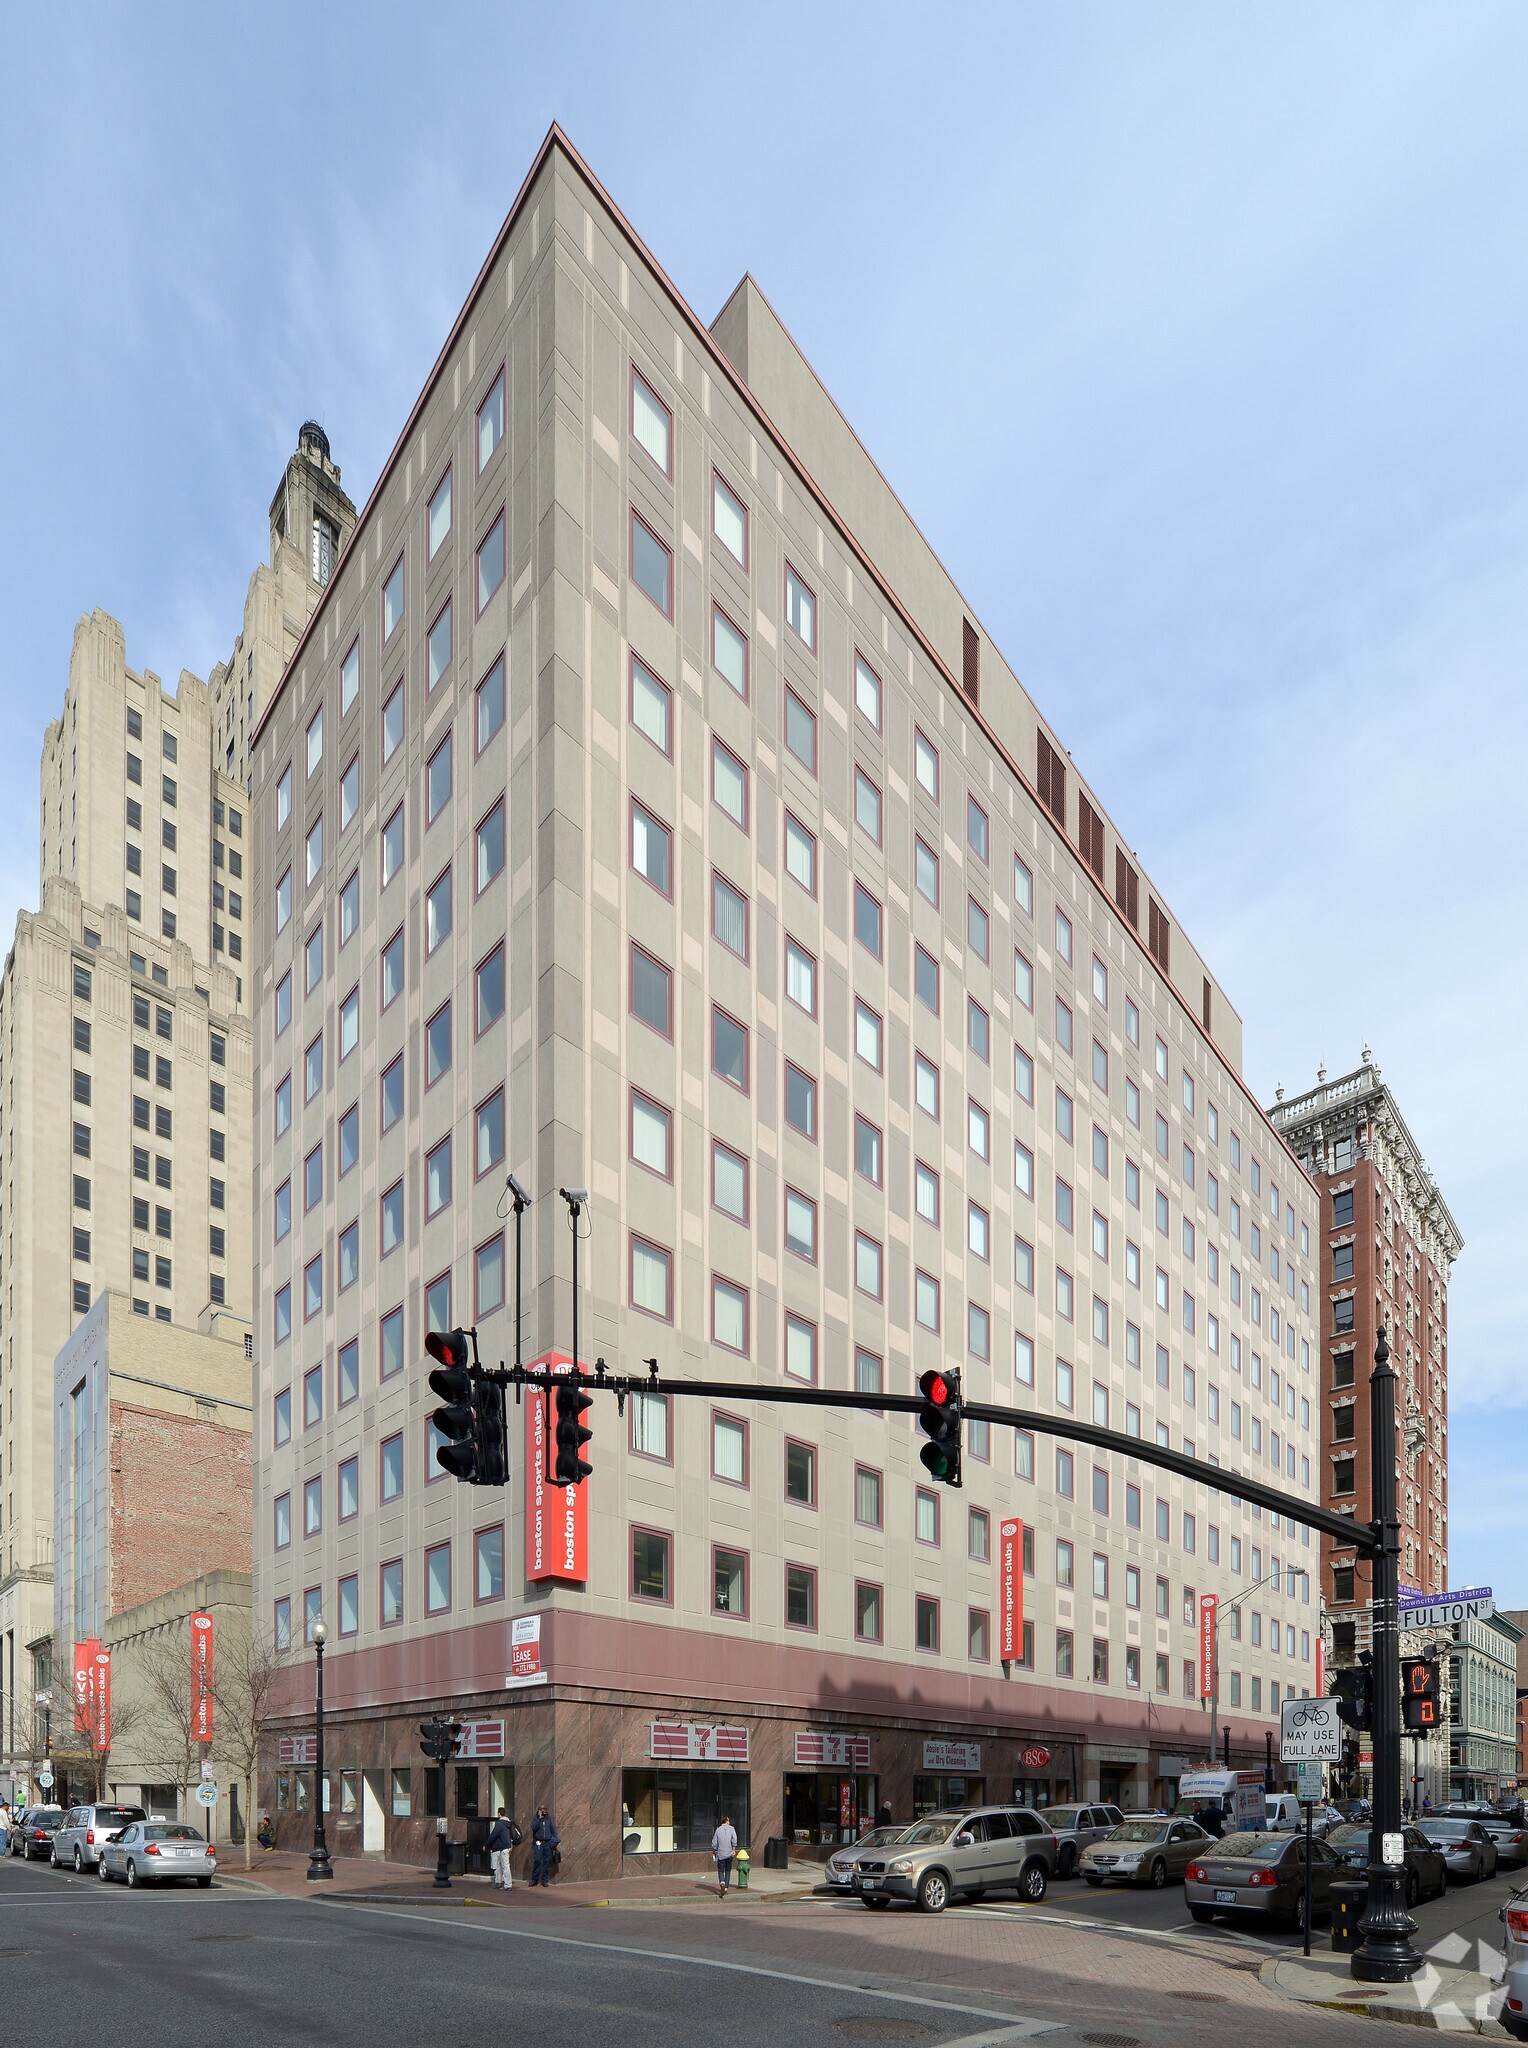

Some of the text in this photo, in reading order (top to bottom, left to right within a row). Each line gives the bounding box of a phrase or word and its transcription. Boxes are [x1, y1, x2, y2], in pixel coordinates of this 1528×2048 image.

[534, 1399, 542, 1446] clubs
[534, 1459, 543, 1507] sports
[534, 1510, 542, 1570] boston
[564, 1510, 574, 1570] boston
[1004, 1542, 1014, 1652] boston sports clubs
[1400, 1588, 1491, 1608] Downcity Arts District
[1404, 1600, 1489, 1628] FULTON ST
[513, 1650, 531, 1663] LEASE
[460, 1726, 472, 1754] 7
[695, 1728, 711, 1757] 7
[1287, 1730, 1334, 1740] MAY USE
[296, 1740, 304, 1761] 7
[828, 1738, 841, 1762] 7
[926, 1744, 966, 1757] Josie's Tailoring
[935, 1755, 945, 1766] Dry
[946, 1756, 967, 1767] Cleaning
[1025, 1749, 1044, 1766] BSC
[1283, 1745, 1337, 1755] FULL LANE
[1300, 1763, 1305, 1771] 2
